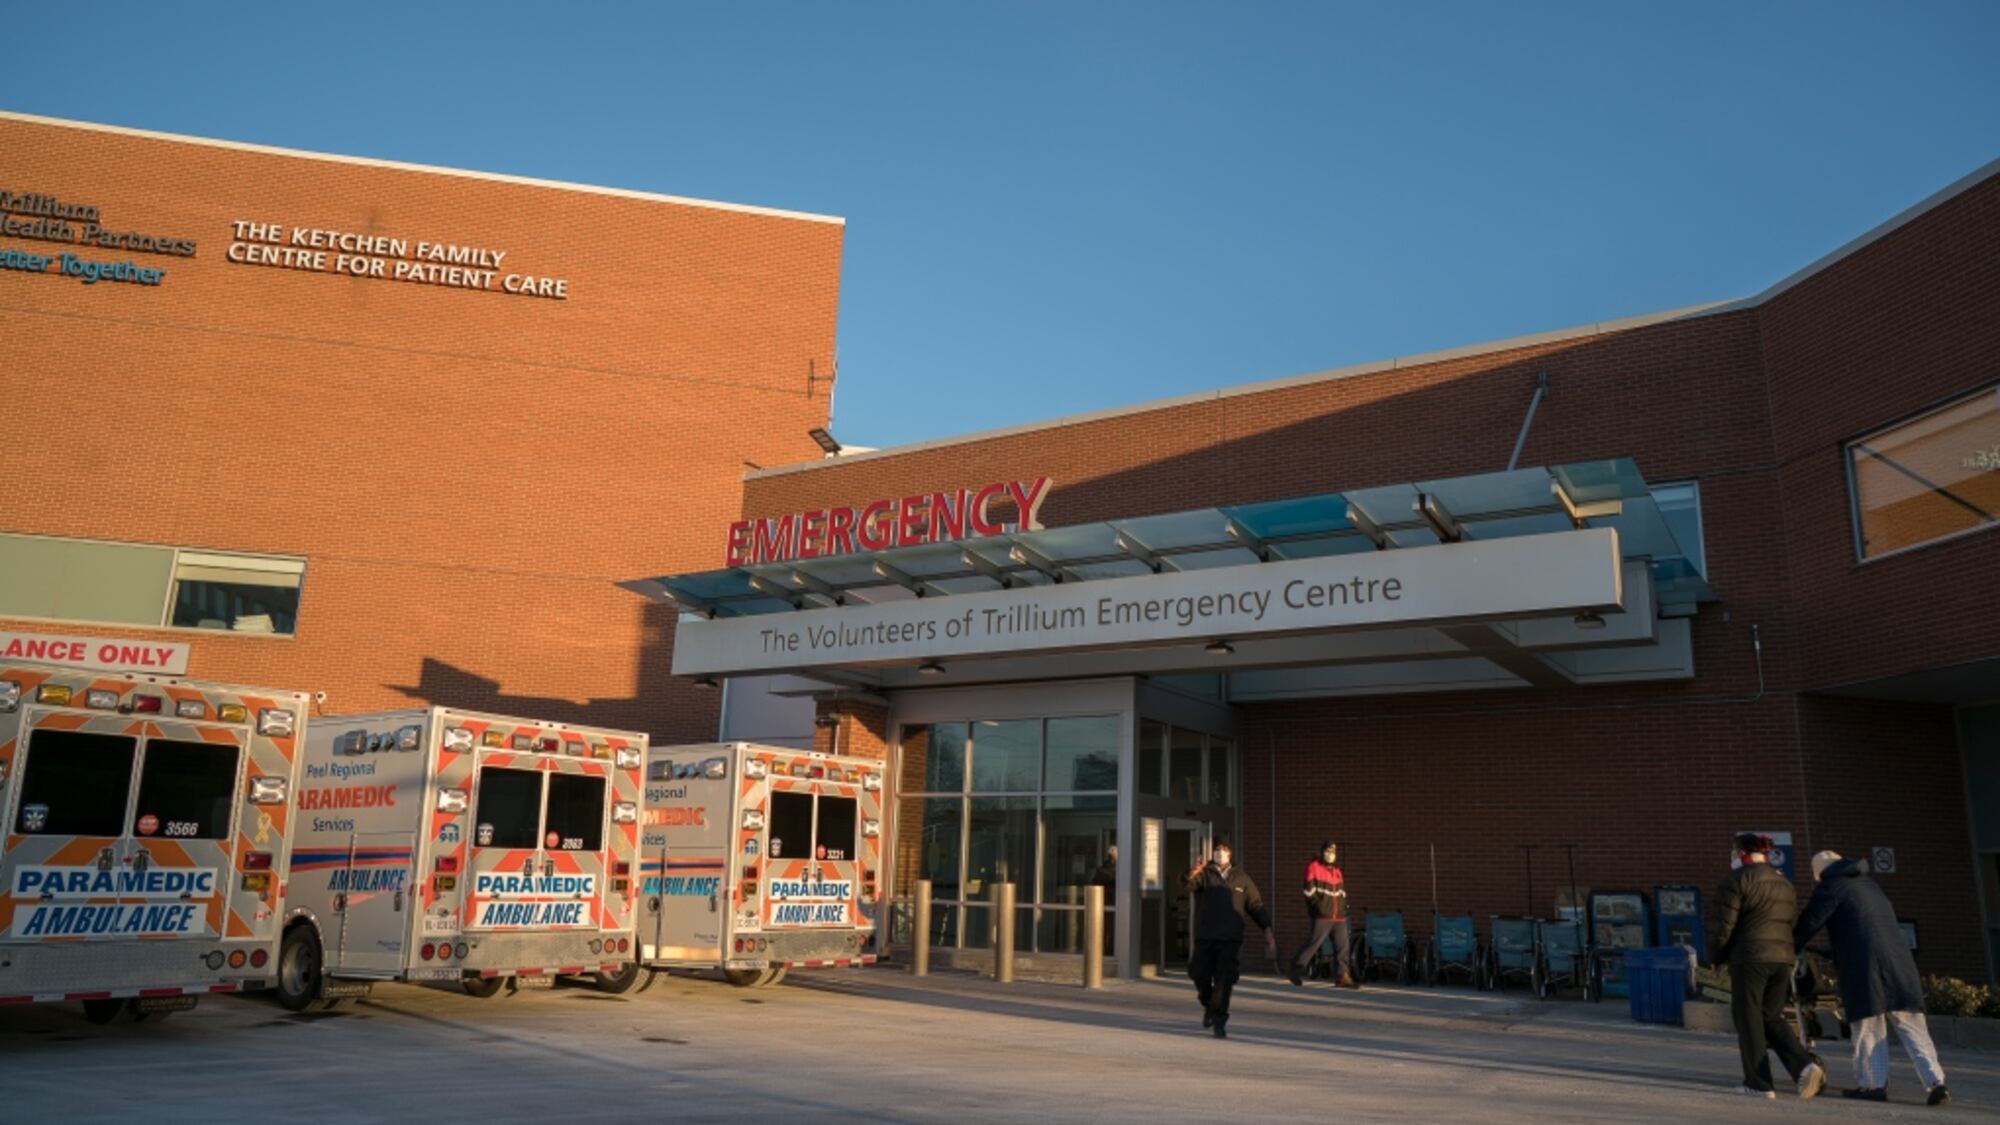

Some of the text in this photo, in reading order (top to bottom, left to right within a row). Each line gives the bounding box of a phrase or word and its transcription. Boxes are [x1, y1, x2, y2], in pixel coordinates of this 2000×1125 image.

[0, 190, 99, 223] rillium
[81, 222, 197, 256] Partners
[232, 219, 507, 269] THE KETCHEN FAMILY
[60, 252, 166, 285] Together
[227, 241, 569, 299] CENTRE FOR PATIENT CARE
[725, 476, 1053, 567] EMERGENCY
[760, 576, 1404, 653] The Volunteers of Trillium Emergency Centre
[0, 638, 175, 667] ANCE ONLY
[165, 820, 199, 836] 3566
[18, 871, 213, 893] PARAMEDIC
[328, 869, 406, 891] AMBULANCE
[477, 875, 593, 893] PARAMEDIC
[643, 877, 721, 897] AMBULANCE
[771, 882, 850, 897] PARAMEDIC
[22, 905, 197, 936] AMBULANCE
[481, 903, 584, 926] AMBULANCE
[774, 904, 844, 924] AMBULANCE
